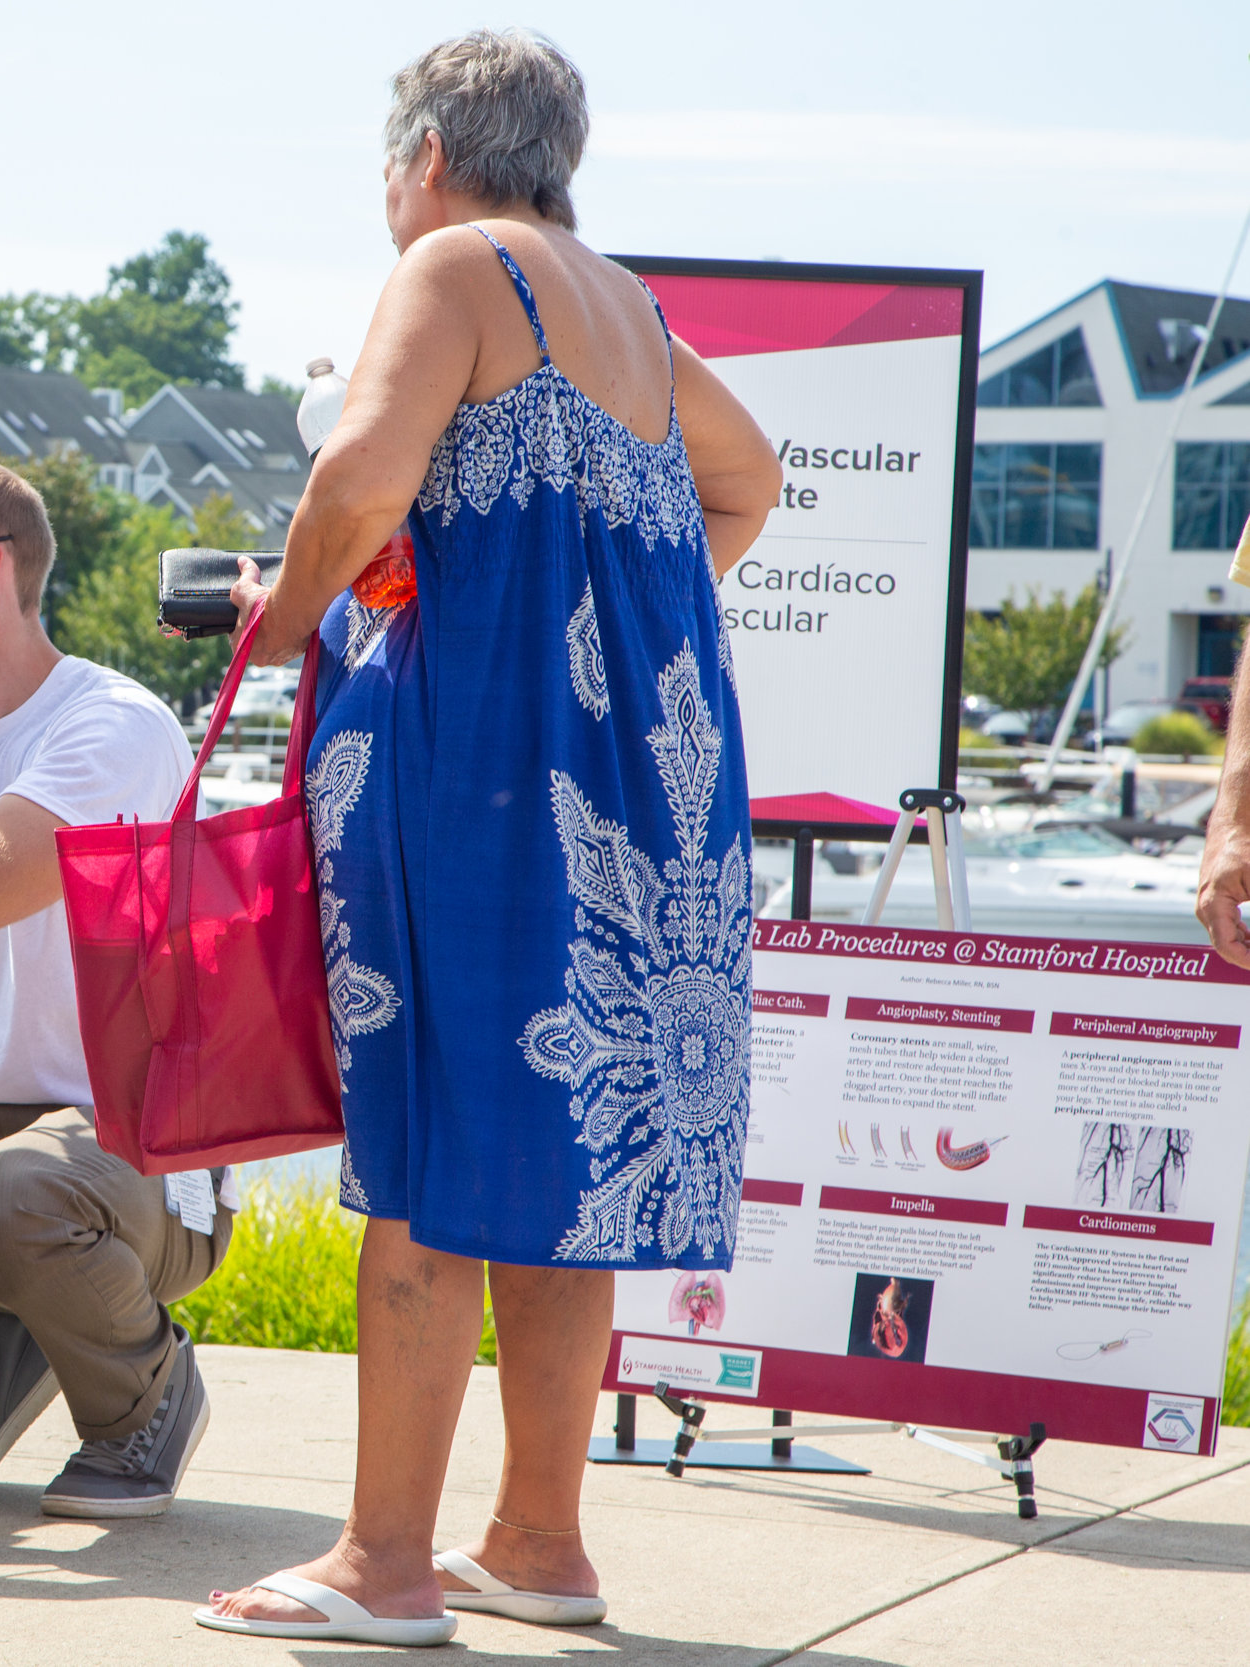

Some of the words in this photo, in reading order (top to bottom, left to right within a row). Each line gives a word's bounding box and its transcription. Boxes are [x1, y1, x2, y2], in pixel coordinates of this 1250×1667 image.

[738, 561, 896, 595] Cardíaco
[724, 604, 829, 633] scular
[767, 925, 811, 948] Lab
[816, 929, 947, 958] Procedures
[954, 939, 976, 963] @
[982, 940, 1099, 971] Stamford
[1101, 949, 1209, 978] Hospital
[926, 977, 951, 985] Rebecca
[777, 996, 806, 1009] Cath.
[877, 1004, 949, 1022] Angioplasty,
[952, 1010, 1001, 1027] Stenting
[751, 1035, 784, 1046] atheter
[1073, 1018, 1135, 1034] Peripheral
[1138, 1023, 1217, 1042] Angiography
[751, 1048, 763, 1057] ein
[850, 1031, 898, 1046] Coronary
[899, 1035, 930, 1047] stents
[932, 1040, 946, 1048] are
[947, 1040, 974, 1051] small,
[976, 1043, 998, 1053] wire,
[846, 1055, 873, 1069] artery
[874, 1058, 891, 1068] and
[893, 1059, 924, 1071] restore
[924, 1062, 965, 1076] adequate
[966, 1065, 992, 1076] blood
[993, 1068, 1012, 1078] flow
[849, 1043, 872, 1054] mesh
[873, 1045, 898, 1056] tubes
[899, 1048, 917, 1058] that
[918, 1049, 938, 1062] help
[939, 1051, 966, 1062] widen
[974, 1054, 1009, 1068] clogged
[1070, 1049, 1119, 1064] peripheral
[1121, 1055, 1172, 1068] angiogram
[1189, 1060, 1204, 1069] test
[1206, 1061, 1222, 1071] that
[856, 1068, 870, 1078] the
[872, 1069, 897, 1081] heart.
[899, 1072, 922, 1083] Once
[923, 1074, 938, 1084] the
[939, 1075, 961, 1086] stent
[963, 1077, 997, 1089] reaches
[998, 1080, 1013, 1090] the
[1059, 1070, 1075, 1080] find
[1077, 1072, 1116, 1083] narrowed
[1127, 1076, 1160, 1087] blocked
[1160, 1081, 1182, 1089] areas
[1194, 1084, 1210, 1092] one
[1060, 1061, 1078, 1069] uses
[1079, 1061, 1106, 1073] X-rays
[1108, 1063, 1124, 1073] and
[1124, 1065, 1140, 1076] dye
[1151, 1067, 1170, 1079] help
[1170, 1071, 1190, 1081] your
[1191, 1071, 1218, 1081] doctor
[843, 1079, 877, 1093] clogged
[877, 1082, 907, 1096] artery,
[908, 1087, 929, 1098] your
[930, 1087, 959, 1098] doctor
[960, 1089, 977, 1100] will
[978, 1091, 1007, 1102] inflate
[1057, 1083, 1078, 1091] more
[1090, 1084, 1103, 1093] the
[1104, 1085, 1135, 1096] arteries
[1137, 1088, 1153, 1098] that
[1155, 1090, 1182, 1102] supply
[1184, 1092, 1208, 1103] blood
[842, 1092, 856, 1102] the
[857, 1093, 890, 1105] balloon
[902, 1097, 934, 1111] expand
[936, 1100, 950, 1110] the
[952, 1101, 976, 1112] stent.
[1054, 1103, 1104, 1118] peripheral
[1104, 1108, 1156, 1122] arteriogram.
[1055, 1094, 1074, 1104] your
[1075, 1094, 1094, 1106] legs.
[1095, 1096, 1111, 1106] The
[1112, 1098, 1128, 1107] test
[1138, 1100, 1155, 1110] also
[1156, 1101, 1181, 1112] called
[891, 1197, 935, 1213] Impella
[1079, 1215, 1156, 1234] Cardiomems
[1034, 1251, 1050, 1261] only
[1051, 1253, 1111, 1267] FDA-approved
[1111, 1259, 1141, 1268] wireless
[1142, 1262, 1162, 1271] heart
[1163, 1264, 1187, 1273] failure
[675, 1365, 702, 1376] HEALTH
